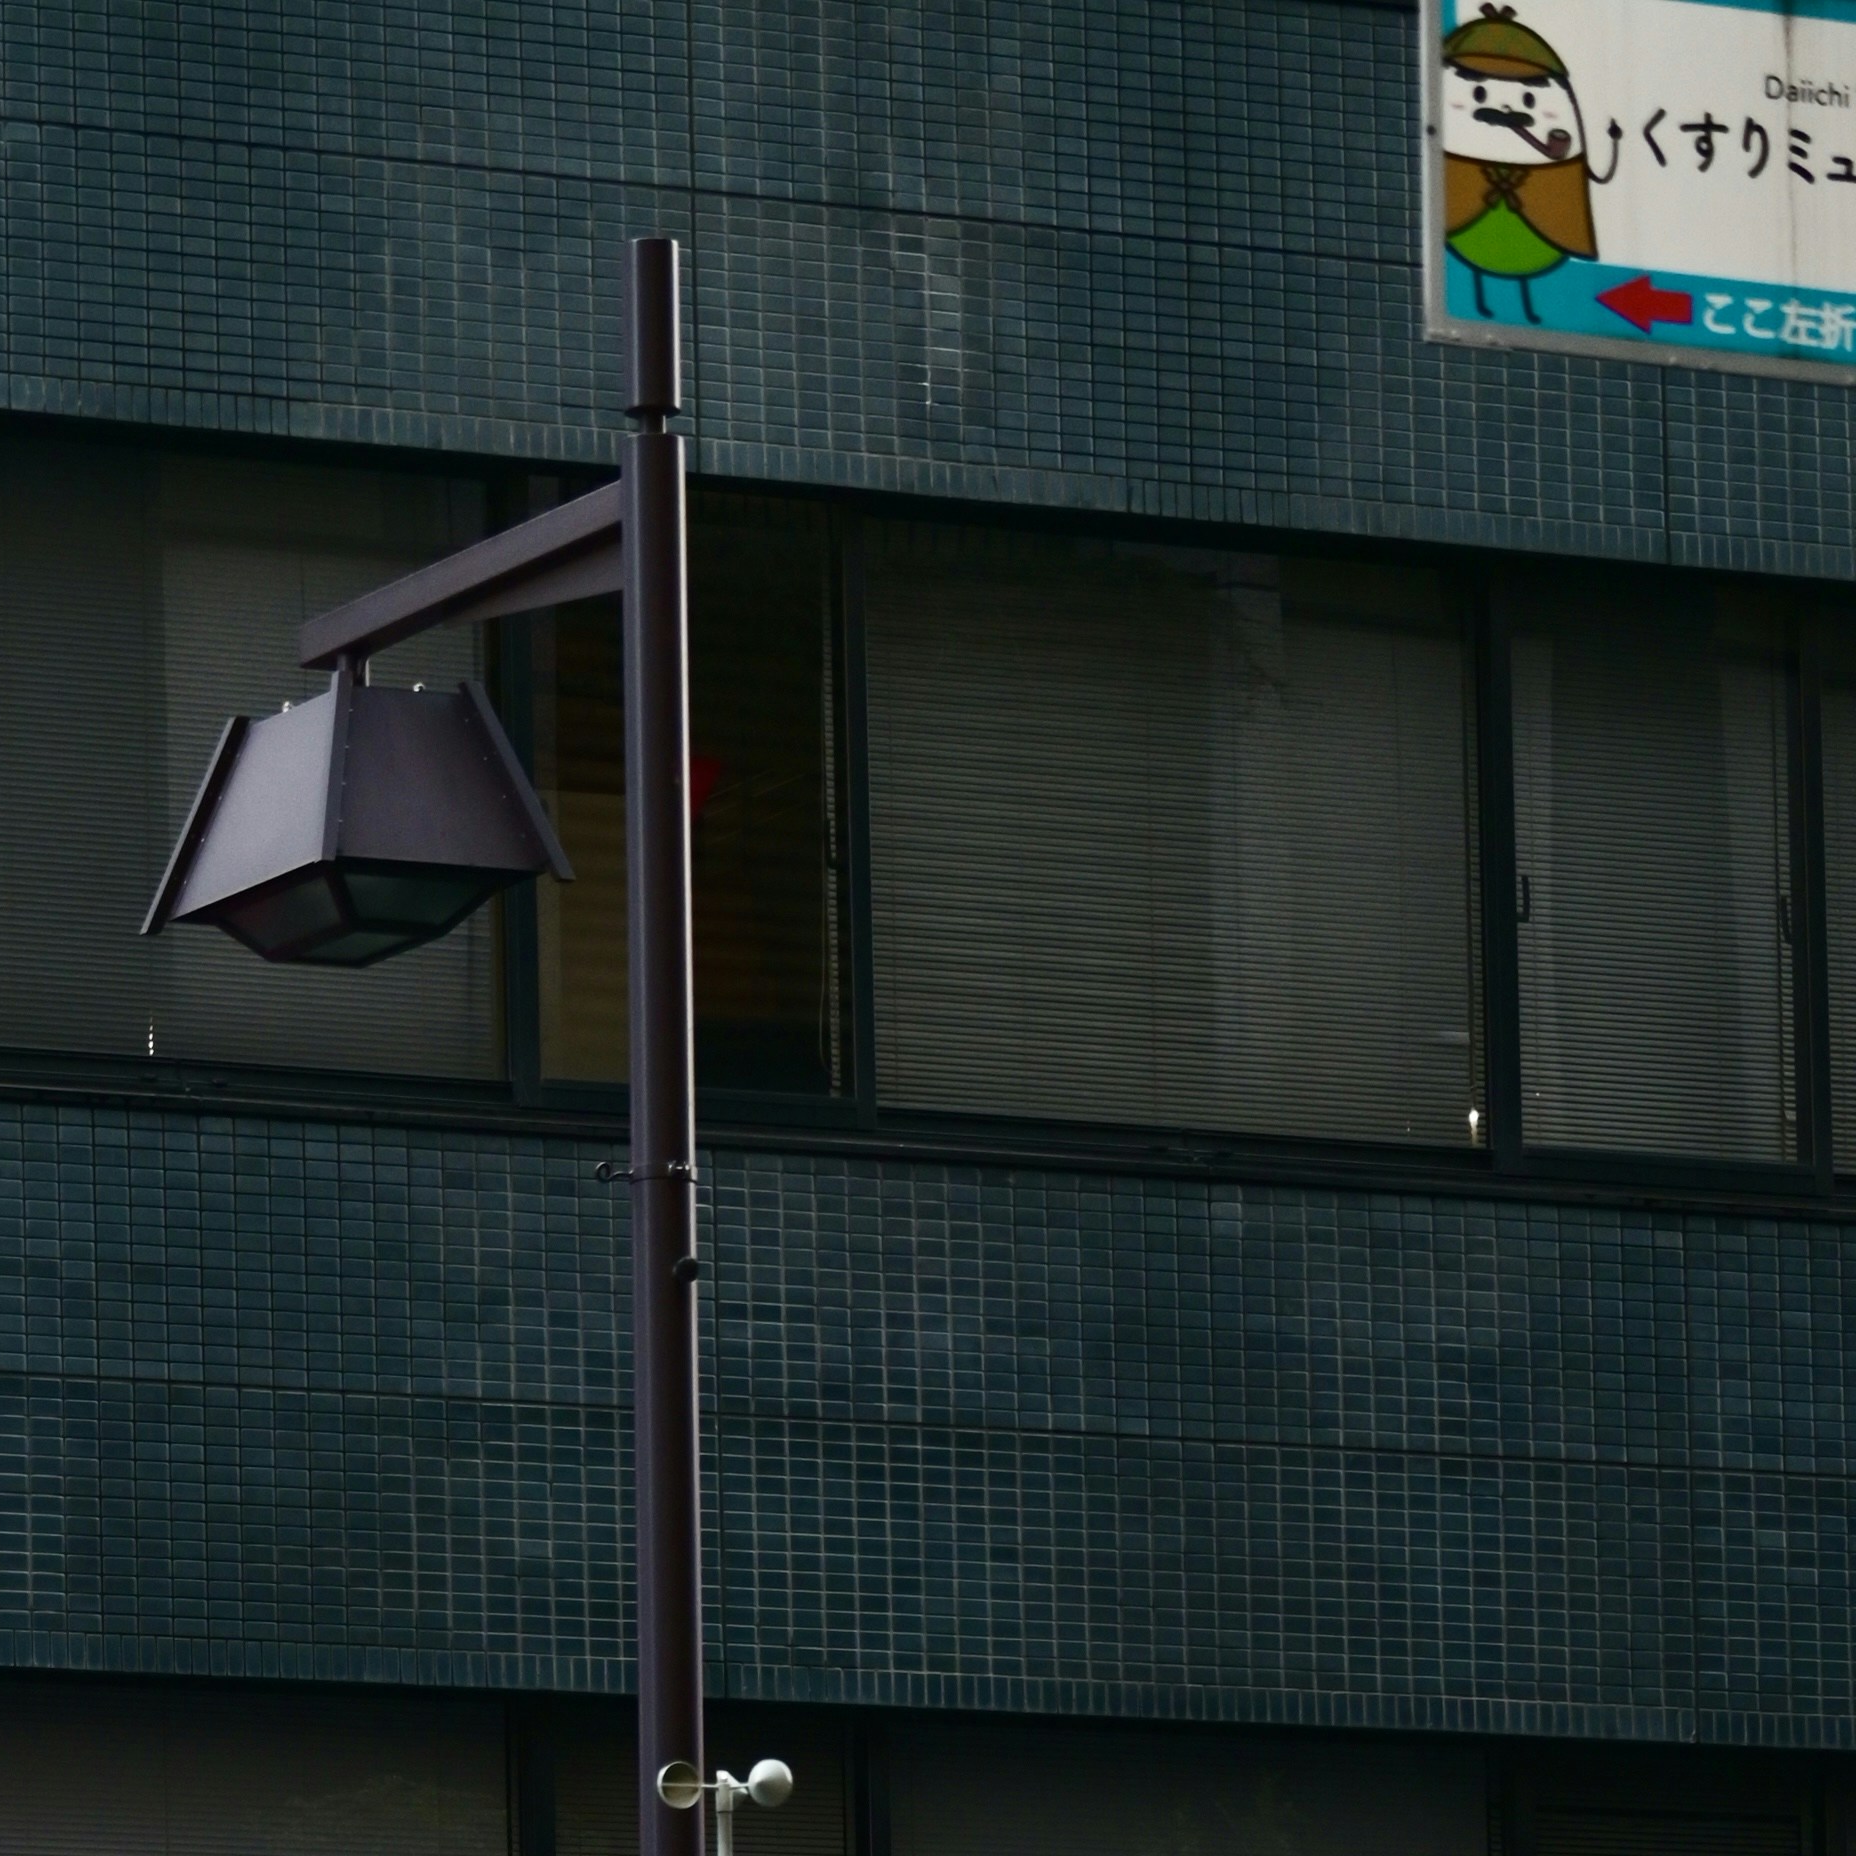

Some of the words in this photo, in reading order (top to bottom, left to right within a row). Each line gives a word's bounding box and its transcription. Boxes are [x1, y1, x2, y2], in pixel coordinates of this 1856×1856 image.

[1764, 74, 1850, 108] Daiichi
[1643, 108, 1856, 184] くすりミュ
[1703, 293, 1856, 353] ここ左折
